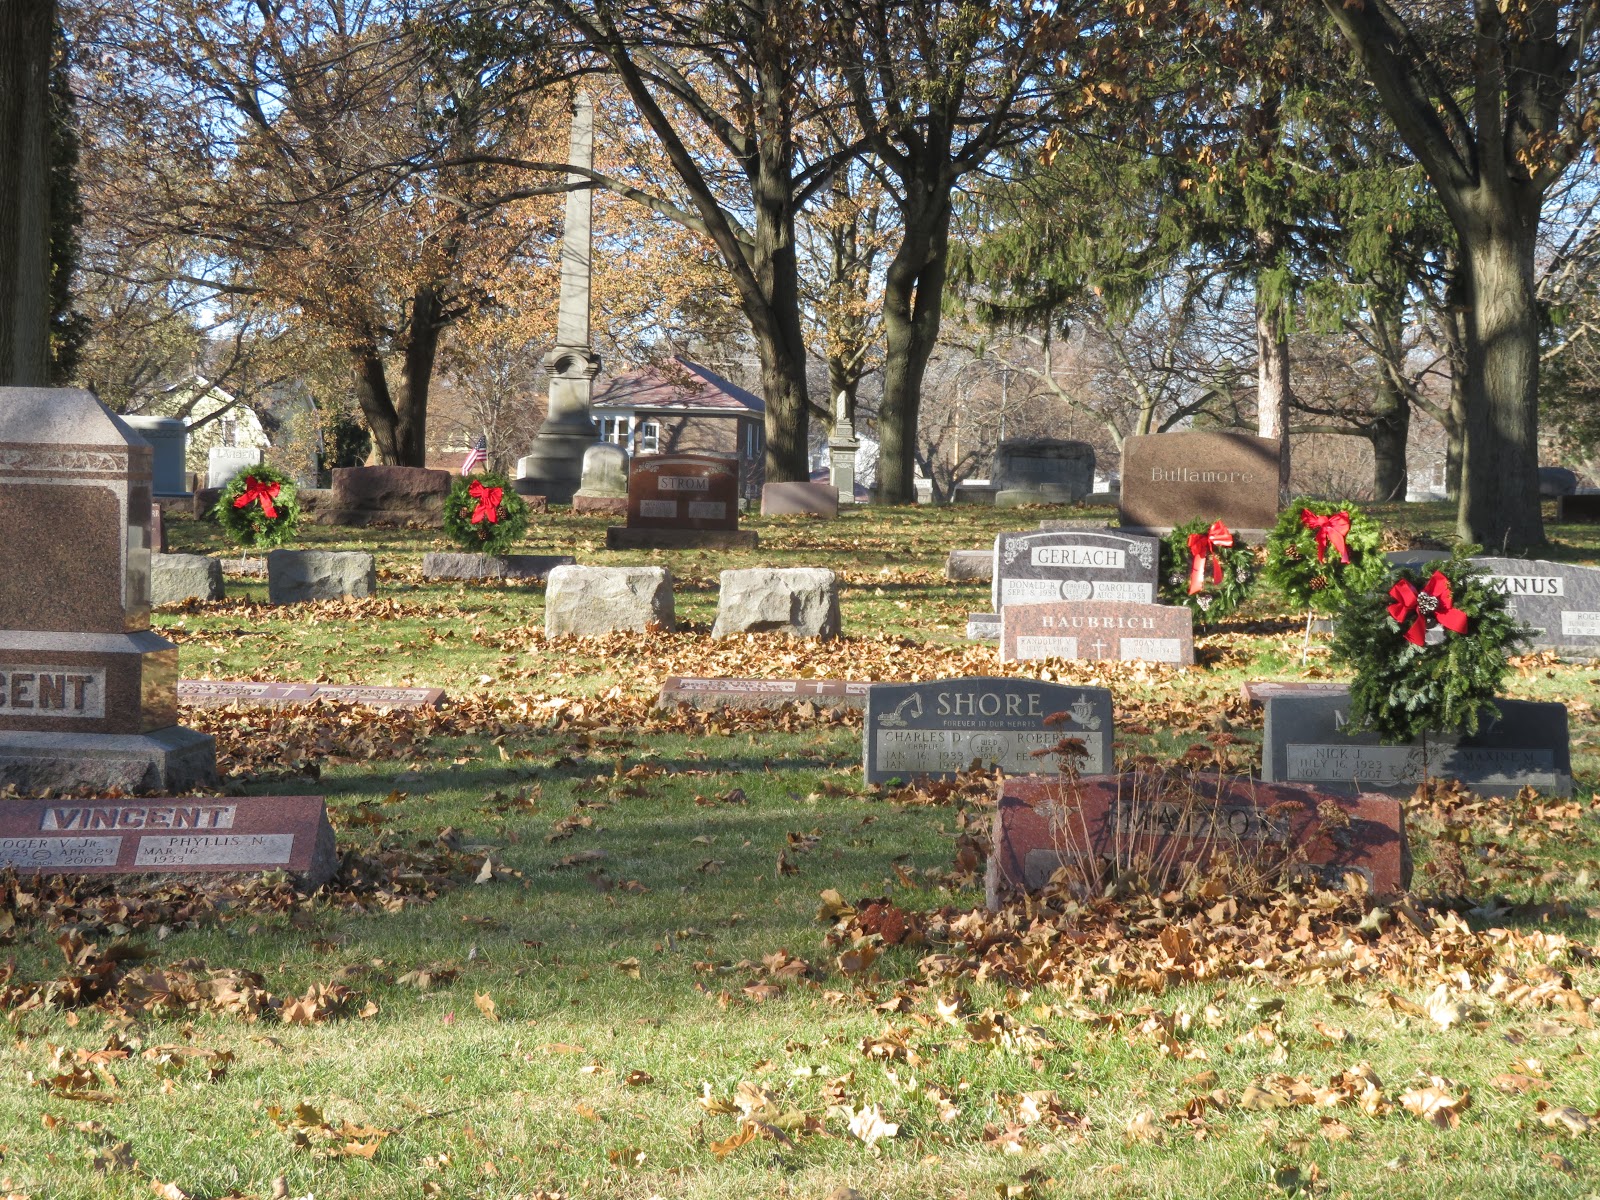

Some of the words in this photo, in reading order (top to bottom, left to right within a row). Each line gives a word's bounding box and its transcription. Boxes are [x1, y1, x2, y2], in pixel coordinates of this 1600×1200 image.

[1151, 467, 1253, 483] Bullamore
[661, 477, 708, 489] STROM
[1038, 549, 1118, 565] GERLACH
[1009, 580, 1046, 590] DONALD
[1098, 583, 1134, 592] CAROLE
[1489, 577, 1558, 594] MNUS
[1128, 592, 1146, 600] 1933
[1042, 616, 1156, 629] HAUBRICH
[1133, 639, 1155, 647] JOAN
[937, 692, 1044, 717] SHORE
[943, 720, 976, 728] FOREVER
[978, 720, 987, 728] IN
[989, 720, 1004, 728] OUR
[1007, 720, 1036, 728] HEARTS
[885, 731, 945, 742] CHARLES
[939, 751, 964, 761] 1933
[1316, 748, 1348, 759] NICK
[939, 760, 964, 769] 1999
[1298, 759, 1328, 768] JULY
[1356, 760, 1382, 770] 1923
[1353, 769, 1382, 779] 2007
[53, 805, 230, 830] VINCENT
[0, 838, 48, 849] OGER
[169, 837, 240, 847] PHYLLIS
[12, 849, 29, 858] 23
[96, 848, 113, 857] 29
[184, 847, 198, 855] 16
[65, 856, 104, 865] 2000
[153, 855, 185, 864] 1933
